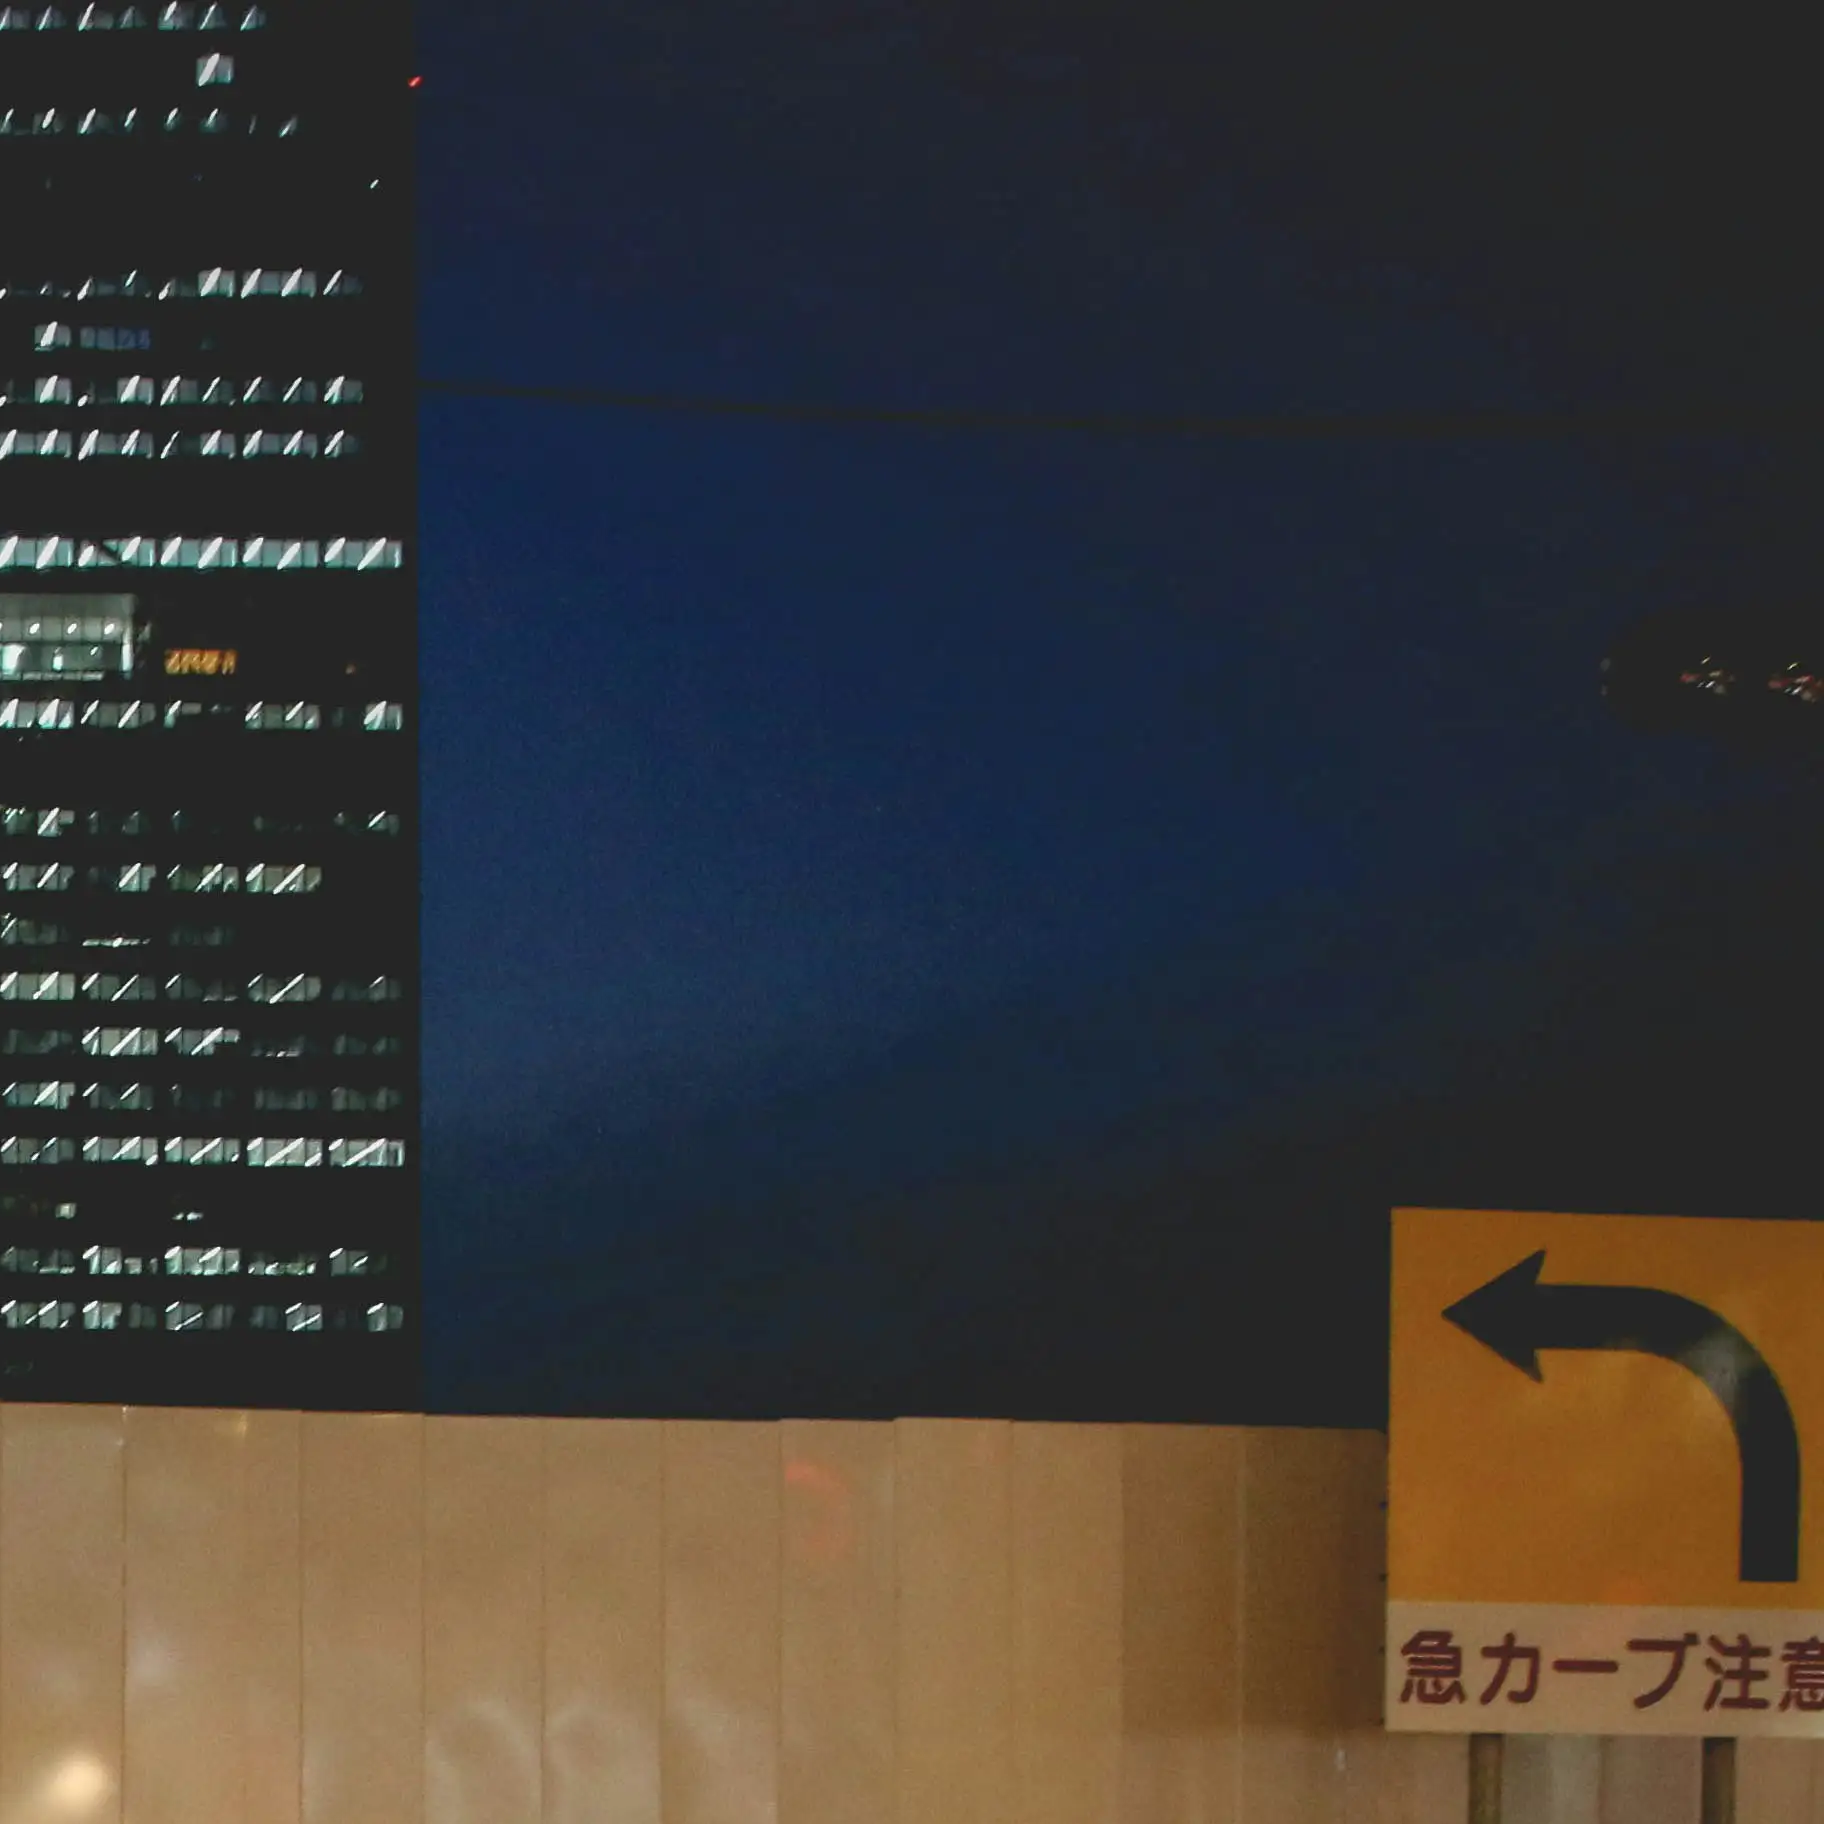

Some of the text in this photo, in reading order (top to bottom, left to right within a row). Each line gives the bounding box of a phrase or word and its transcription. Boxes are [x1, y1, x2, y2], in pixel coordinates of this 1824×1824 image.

[1399, 1630, 1824, 1711] 急カーブ注意
